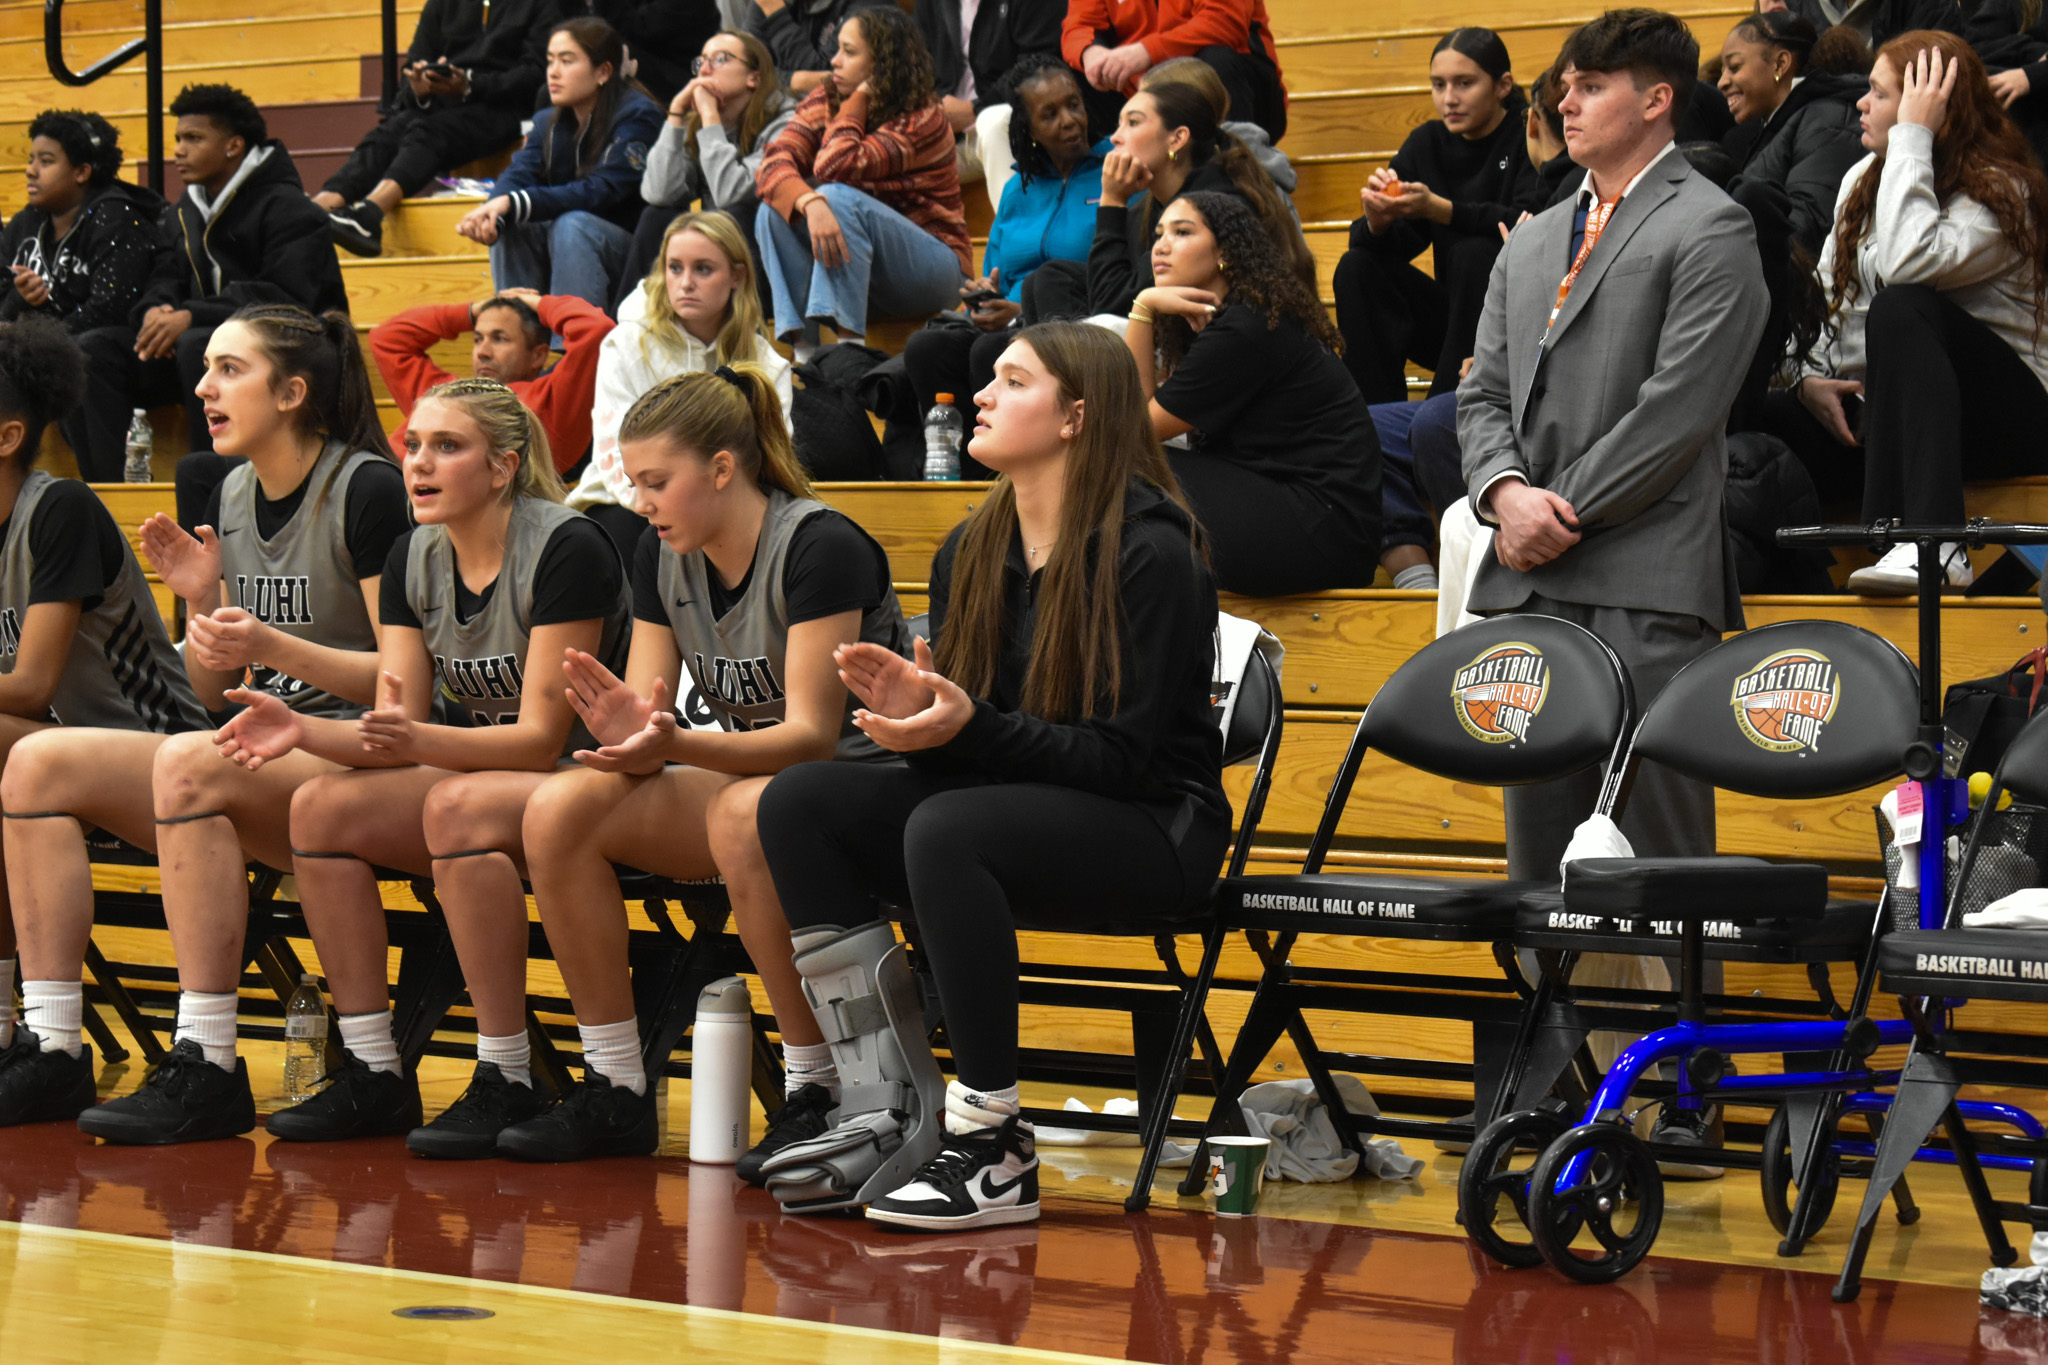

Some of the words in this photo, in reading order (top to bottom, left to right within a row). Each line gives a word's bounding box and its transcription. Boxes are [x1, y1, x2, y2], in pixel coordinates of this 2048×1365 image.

[237, 575, 313, 624] LUHI
[434, 653, 524, 700] LUHI
[694, 652, 786, 707] LUHI
[1457, 656, 1543, 689] BASKETBALL
[1738, 663, 1831, 696] BASKETBALL
[1488, 684, 1515, 704] HALL
[1521, 686, 1539, 709] OF
[1773, 692, 1802, 712] HALL
[1810, 694, 1829, 717] OF
[1498, 705, 1533, 744] FAME
[1736, 710, 1769, 747] SPRINGFIELD
[1784, 712, 1824, 753] FAME
[1242, 893, 1319, 913] BASKETBALL
[1323, 898, 1354, 915] HALL
[1357, 900, 1375, 916] OF
[1378, 902, 1416, 919] FAME
[1916, 953, 2016, 977] BASKETBALL
